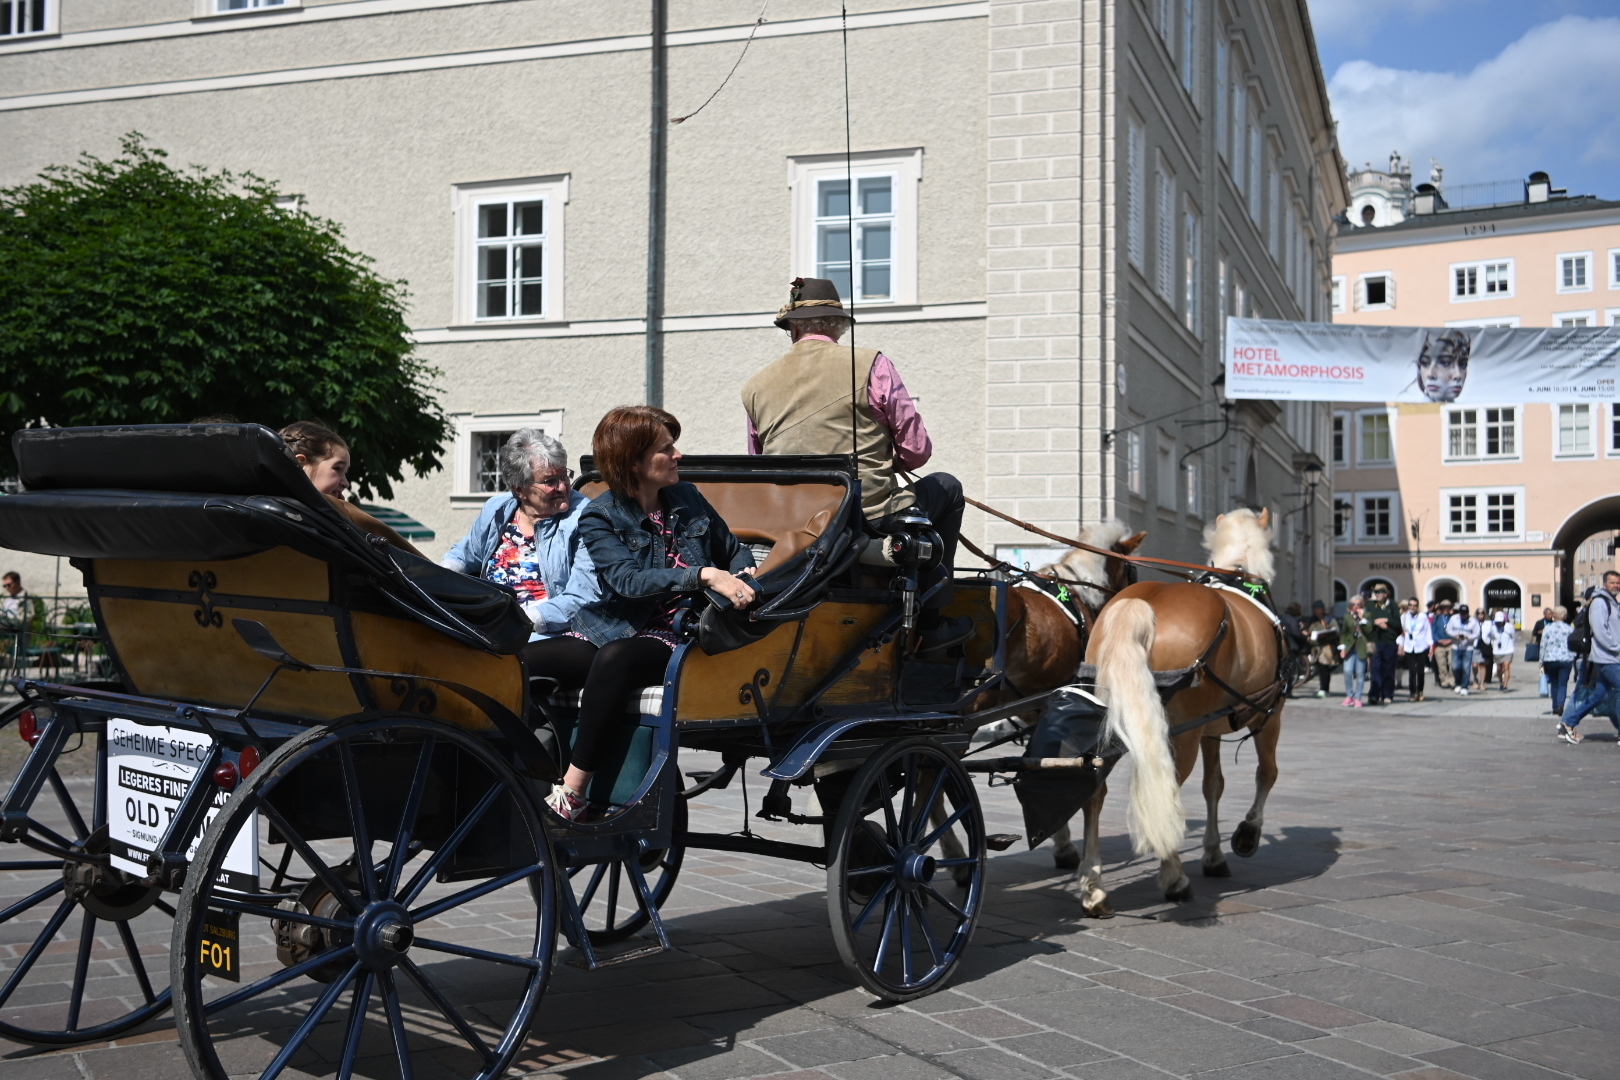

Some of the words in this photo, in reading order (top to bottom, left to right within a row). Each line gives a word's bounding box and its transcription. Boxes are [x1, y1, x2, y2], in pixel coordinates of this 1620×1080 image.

[1233, 347, 1281, 362] HOTEL
[1232, 362, 1365, 380] METAMORPHOSIS
[1460, 560, 1510, 570] HÖLLRIGL
[113, 727, 166, 756] GEHEIME
[169, 739, 211, 763] SPEC
[120, 768, 162, 794] LEGERES
[125, 796, 160, 828] OLD
[209, 924, 236, 940] SALZBURG
